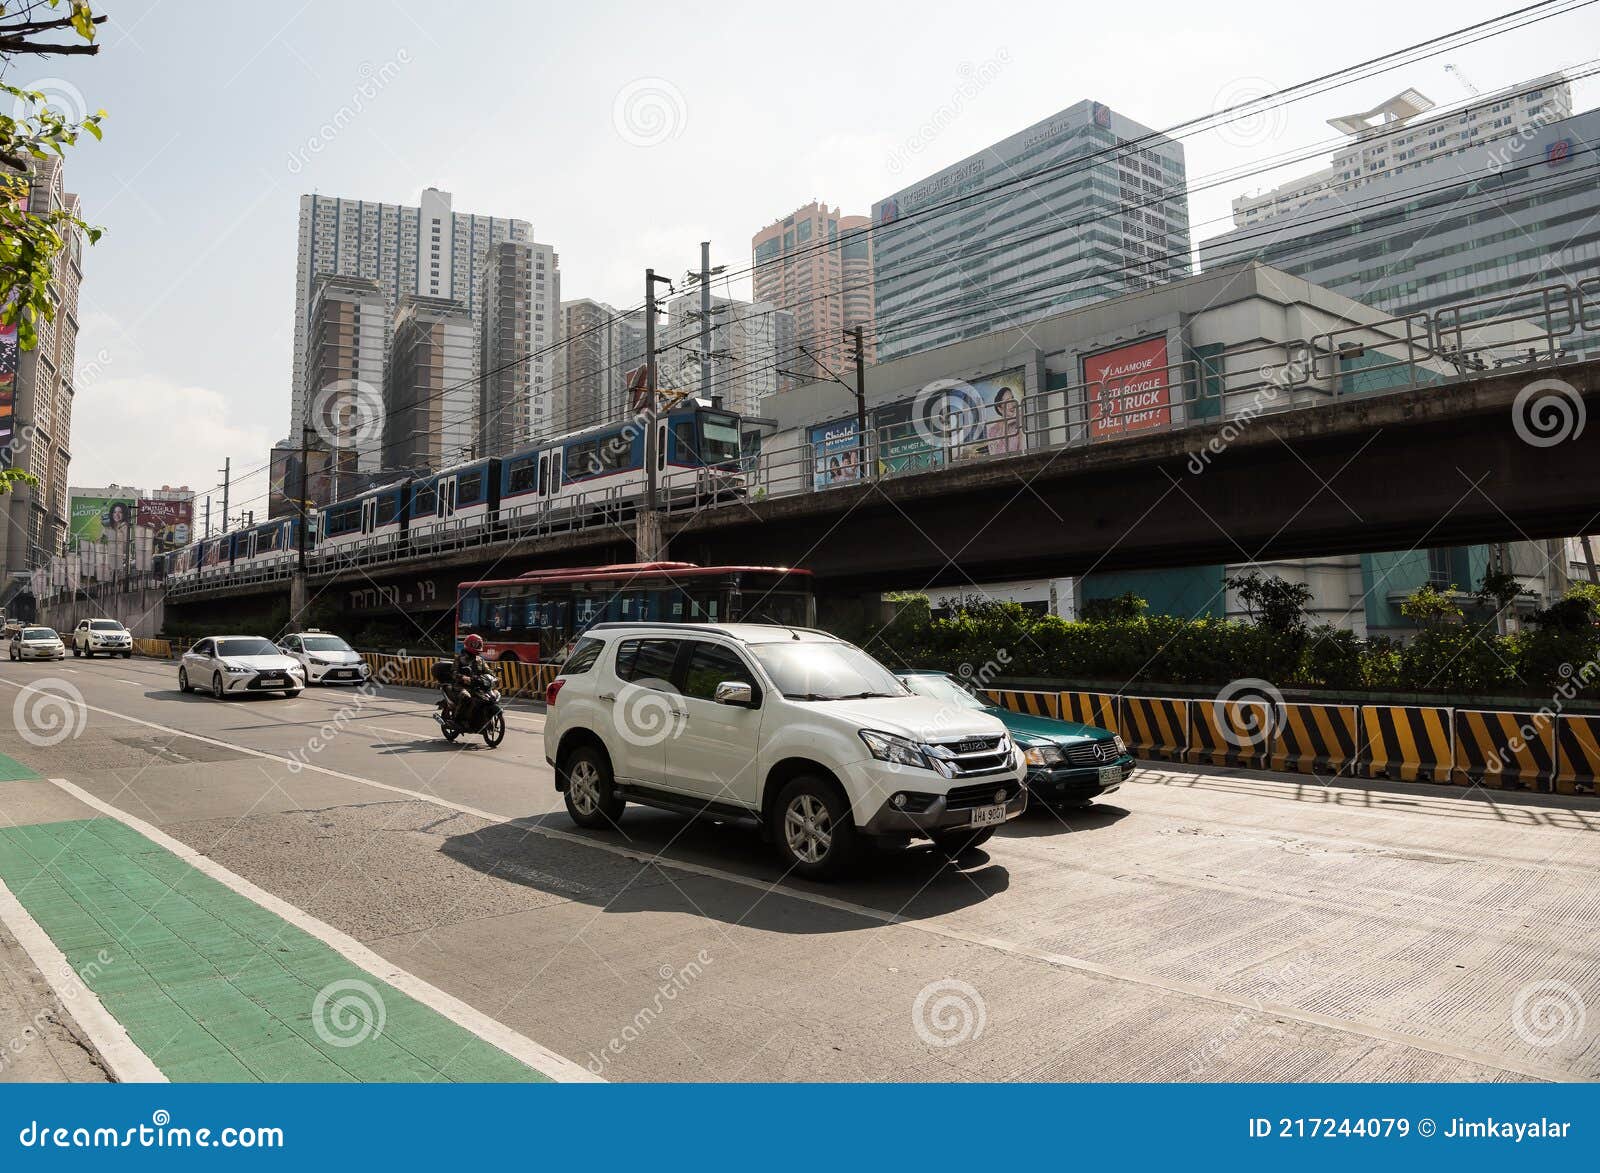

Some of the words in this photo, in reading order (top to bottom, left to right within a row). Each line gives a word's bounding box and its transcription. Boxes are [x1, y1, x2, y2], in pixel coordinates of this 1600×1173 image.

[1109, 359, 1152, 376] LALAMOVE
[1118, 390, 1161, 411] TRUCK
[825, 426, 854, 446] Shield
[960, 741, 987, 752] ISUZU
